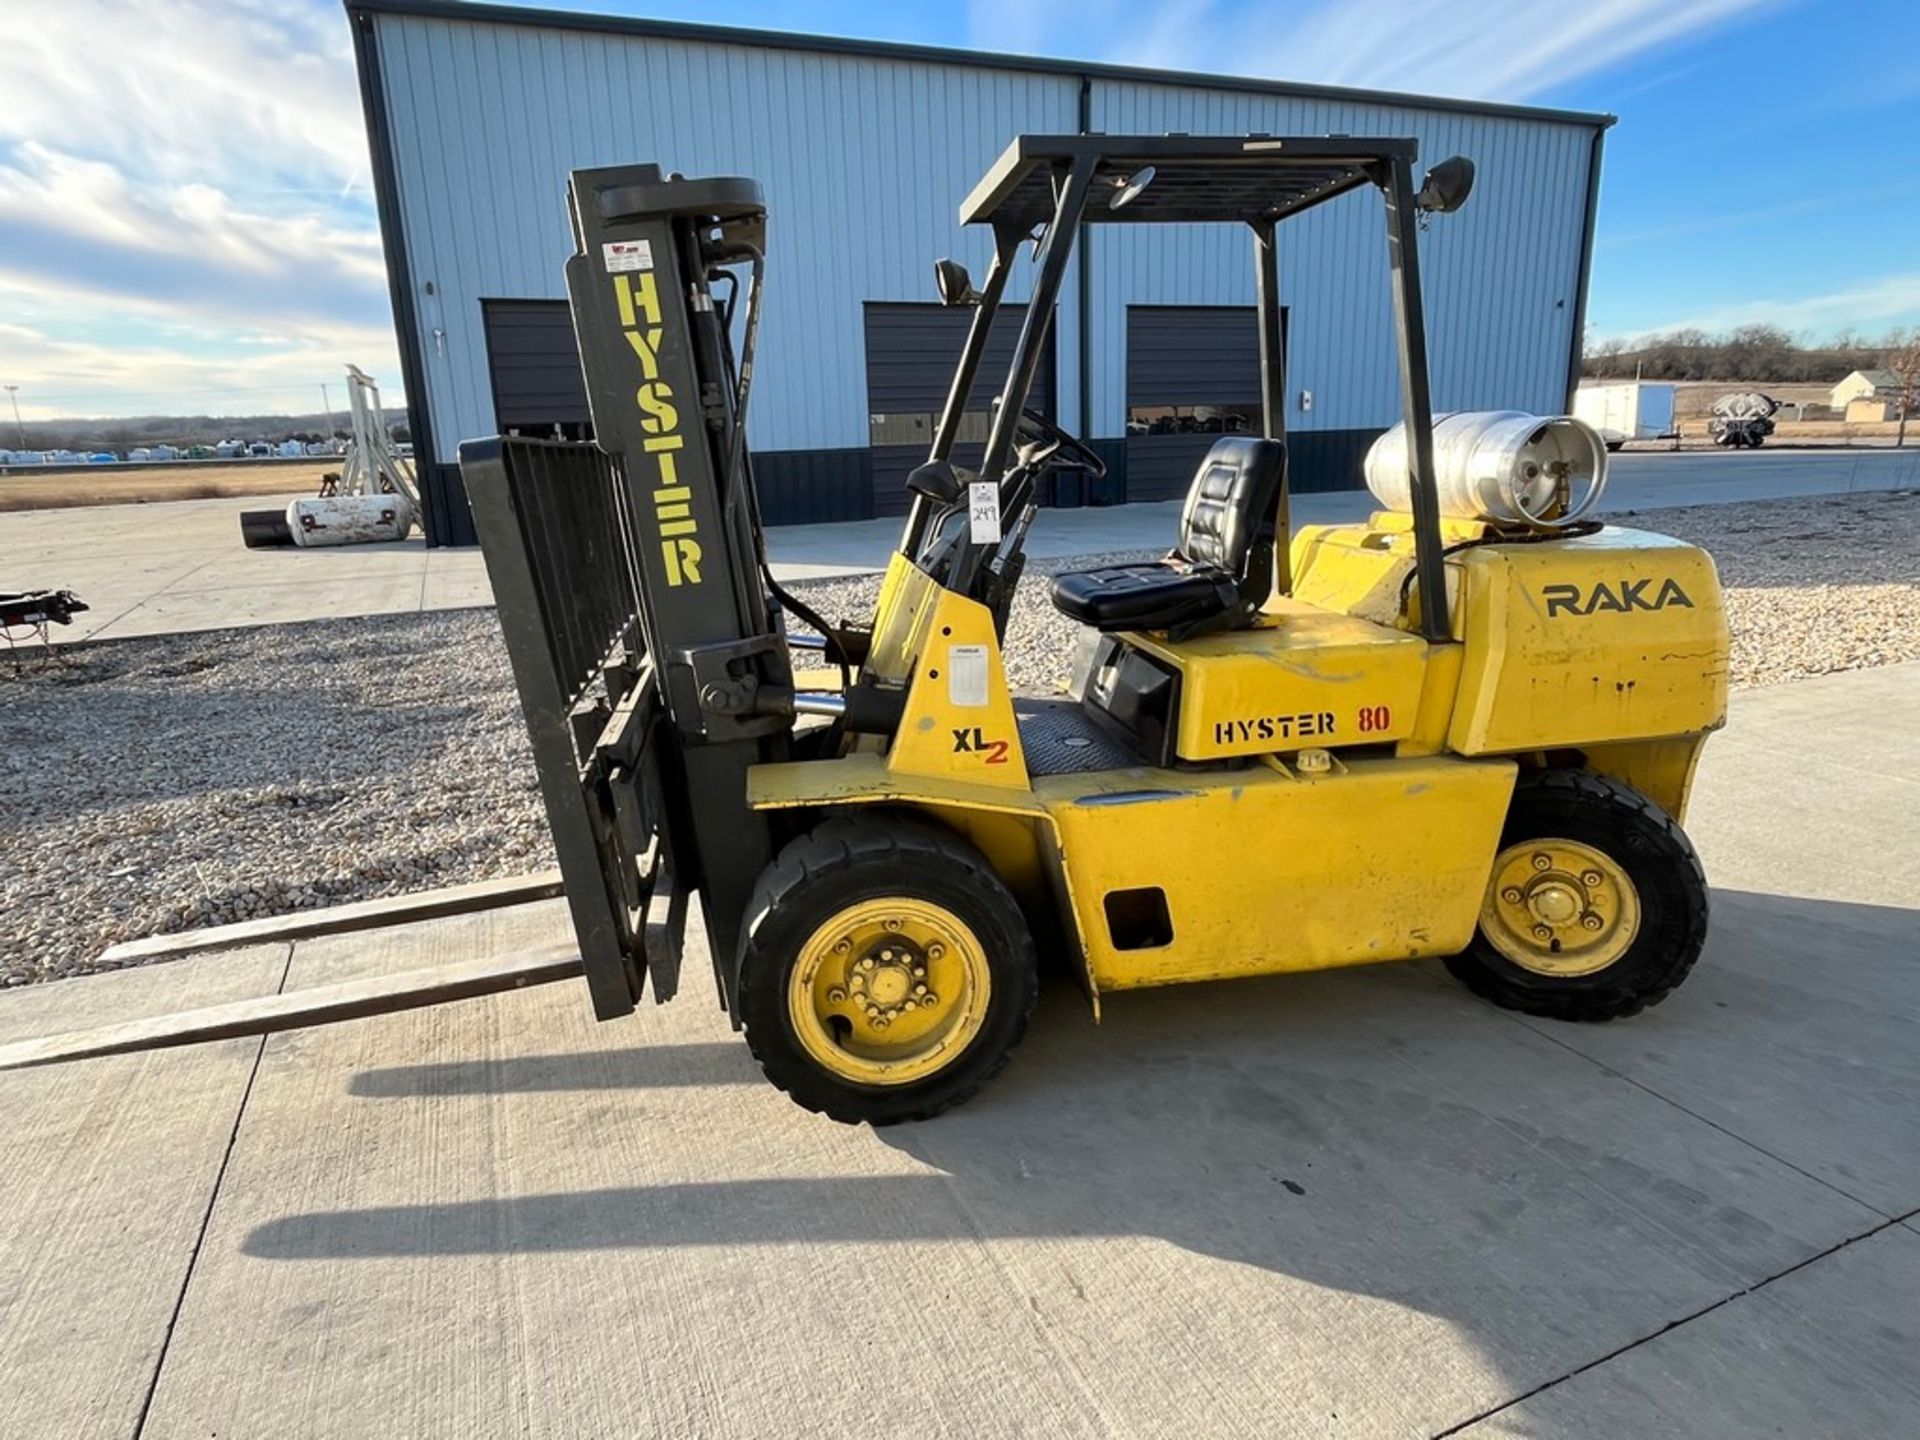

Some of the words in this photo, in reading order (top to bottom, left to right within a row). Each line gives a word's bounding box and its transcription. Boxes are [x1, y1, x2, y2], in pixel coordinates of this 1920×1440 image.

[614, 272, 702, 587] HYSTER
[1542, 578, 1695, 618] RAKA
[1215, 713, 1336, 744] HYSTER
[1358, 706, 1391, 732] 80
